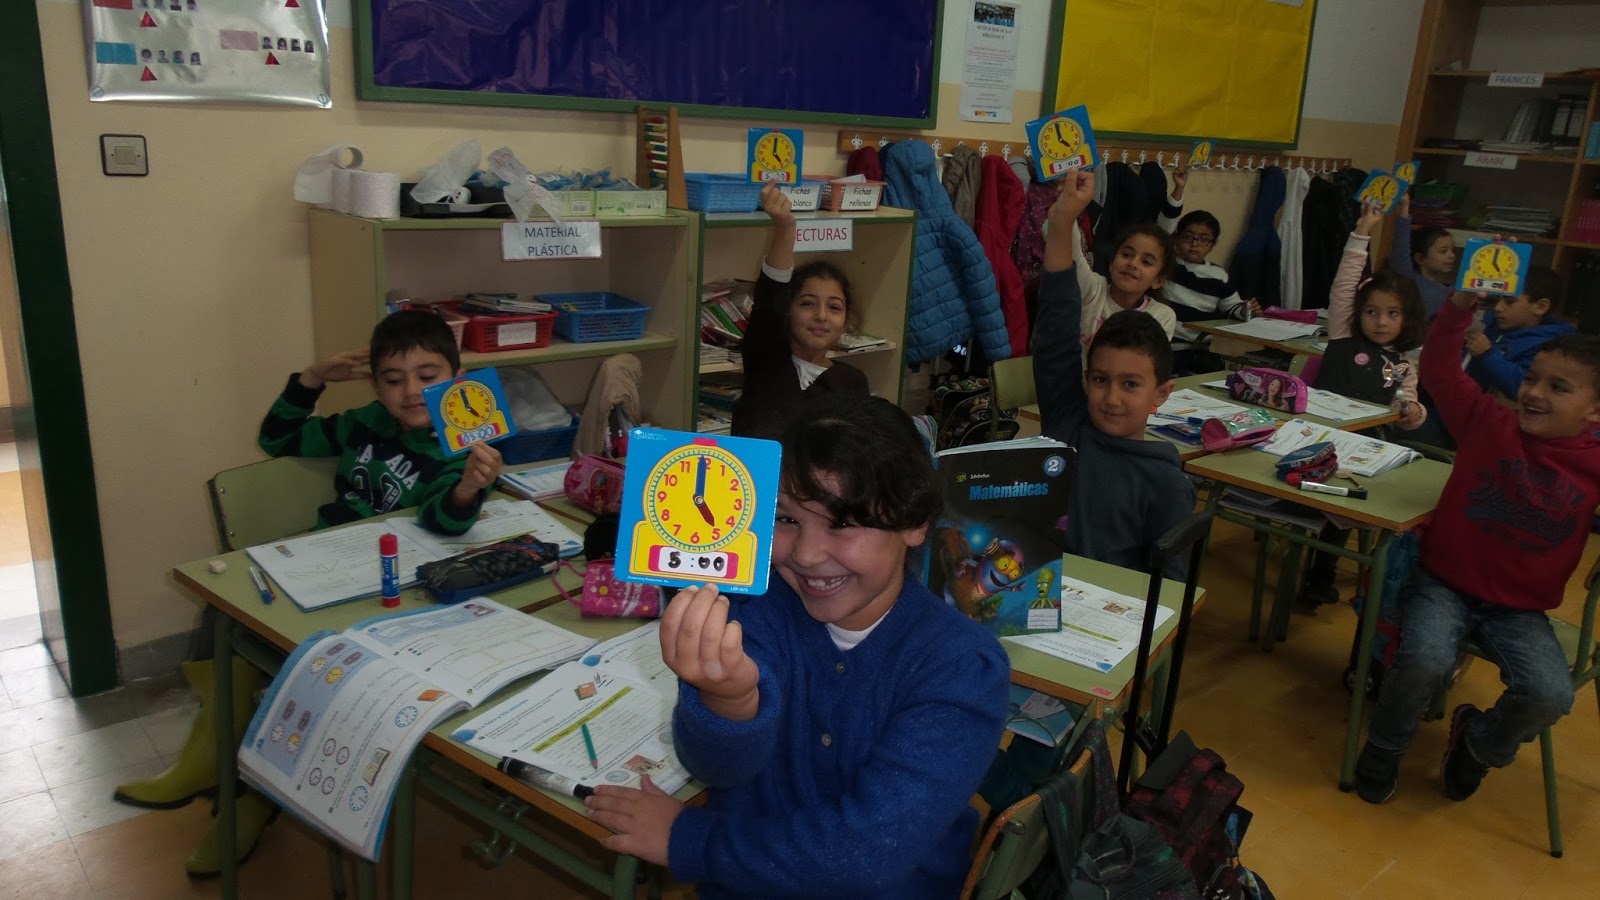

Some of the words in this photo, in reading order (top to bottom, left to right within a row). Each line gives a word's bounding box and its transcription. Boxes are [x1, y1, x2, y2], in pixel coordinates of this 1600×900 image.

[853, 186, 872, 195] Fichas
[792, 199, 812, 207] blanco
[849, 199, 871, 207] rellenas
[524, 226, 581, 238] MATERIAL
[796, 227, 848, 243] ECTURAS
[528, 243, 579, 257] PLÁSTICA
[680, 460, 691, 473] 11
[720, 464, 726, 476] 1
[1047, 459, 1059, 472] 2
[664, 474, 678, 487] 10
[730, 479, 739, 491] 2
[657, 490, 667, 503] 9
[969, 481, 1049, 500] Matemáticas
[733, 499, 743, 511] 3
[661, 509, 670, 521] 8
[726, 516, 735, 528] 4
[673, 524, 682, 536] 7
[711, 528, 721, 540] 5
[690, 532, 700, 544] 6
